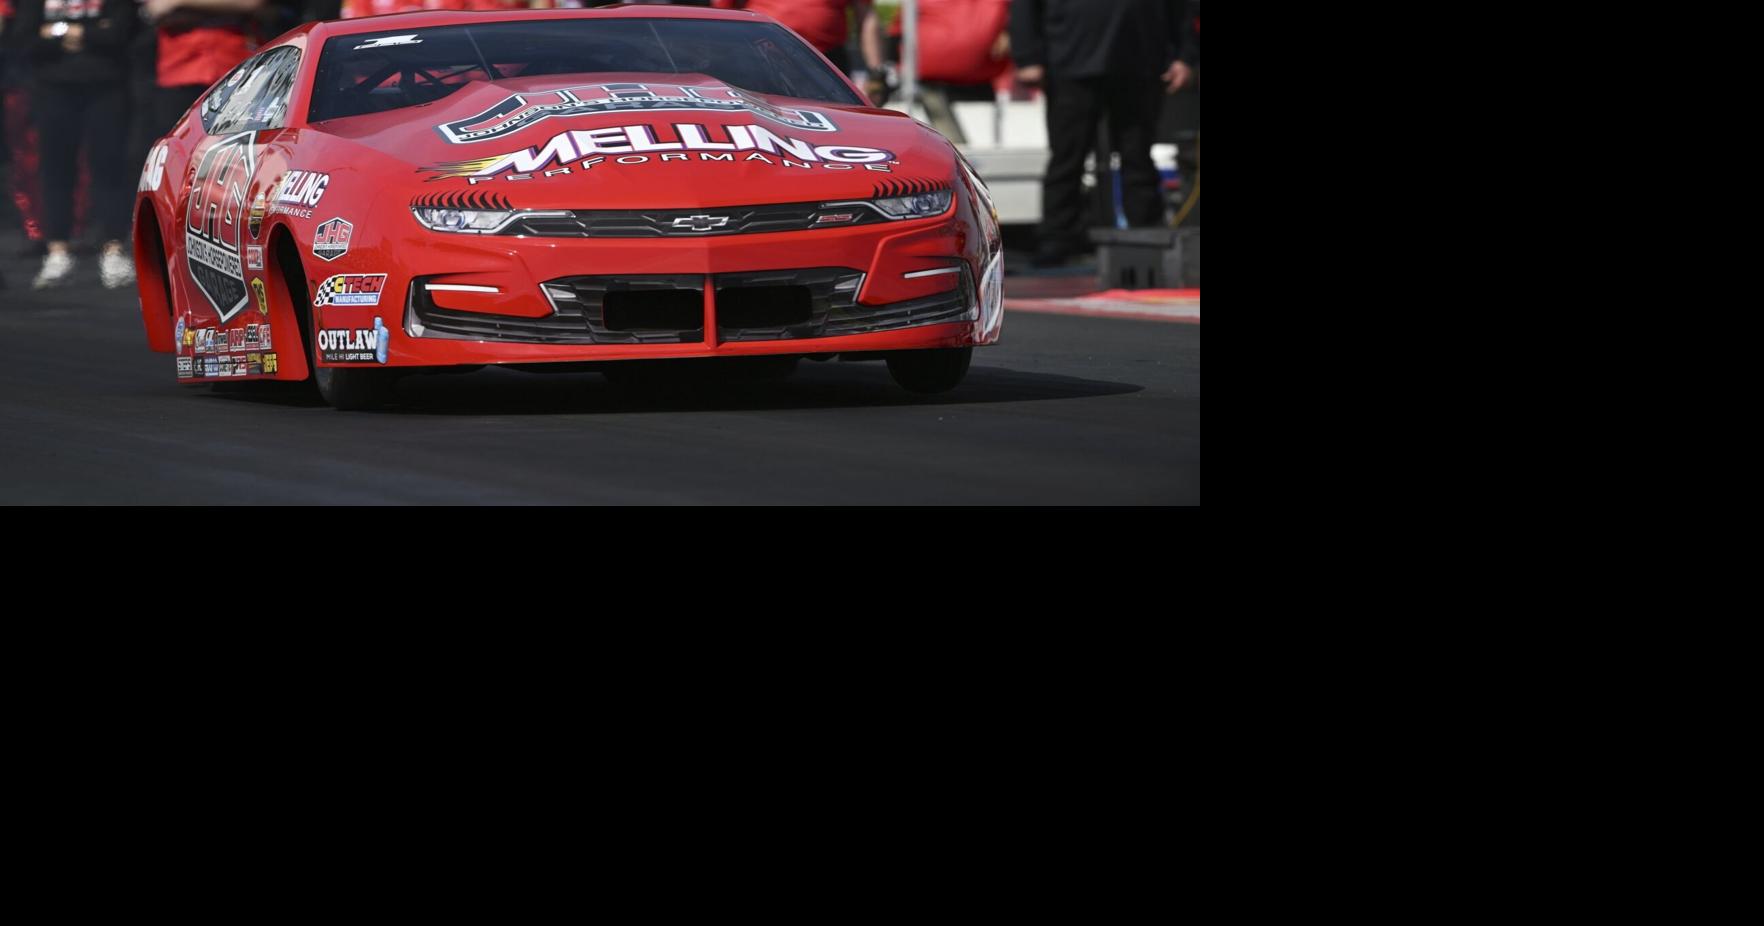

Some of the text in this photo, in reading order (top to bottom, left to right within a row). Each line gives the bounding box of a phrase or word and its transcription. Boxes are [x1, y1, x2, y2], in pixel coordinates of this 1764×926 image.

[471, 124, 888, 176] MELLING
[468, 152, 892, 184] PERFORMANCE
[316, 221, 350, 243] JHG
[318, 329, 378, 351] OUTLAW
